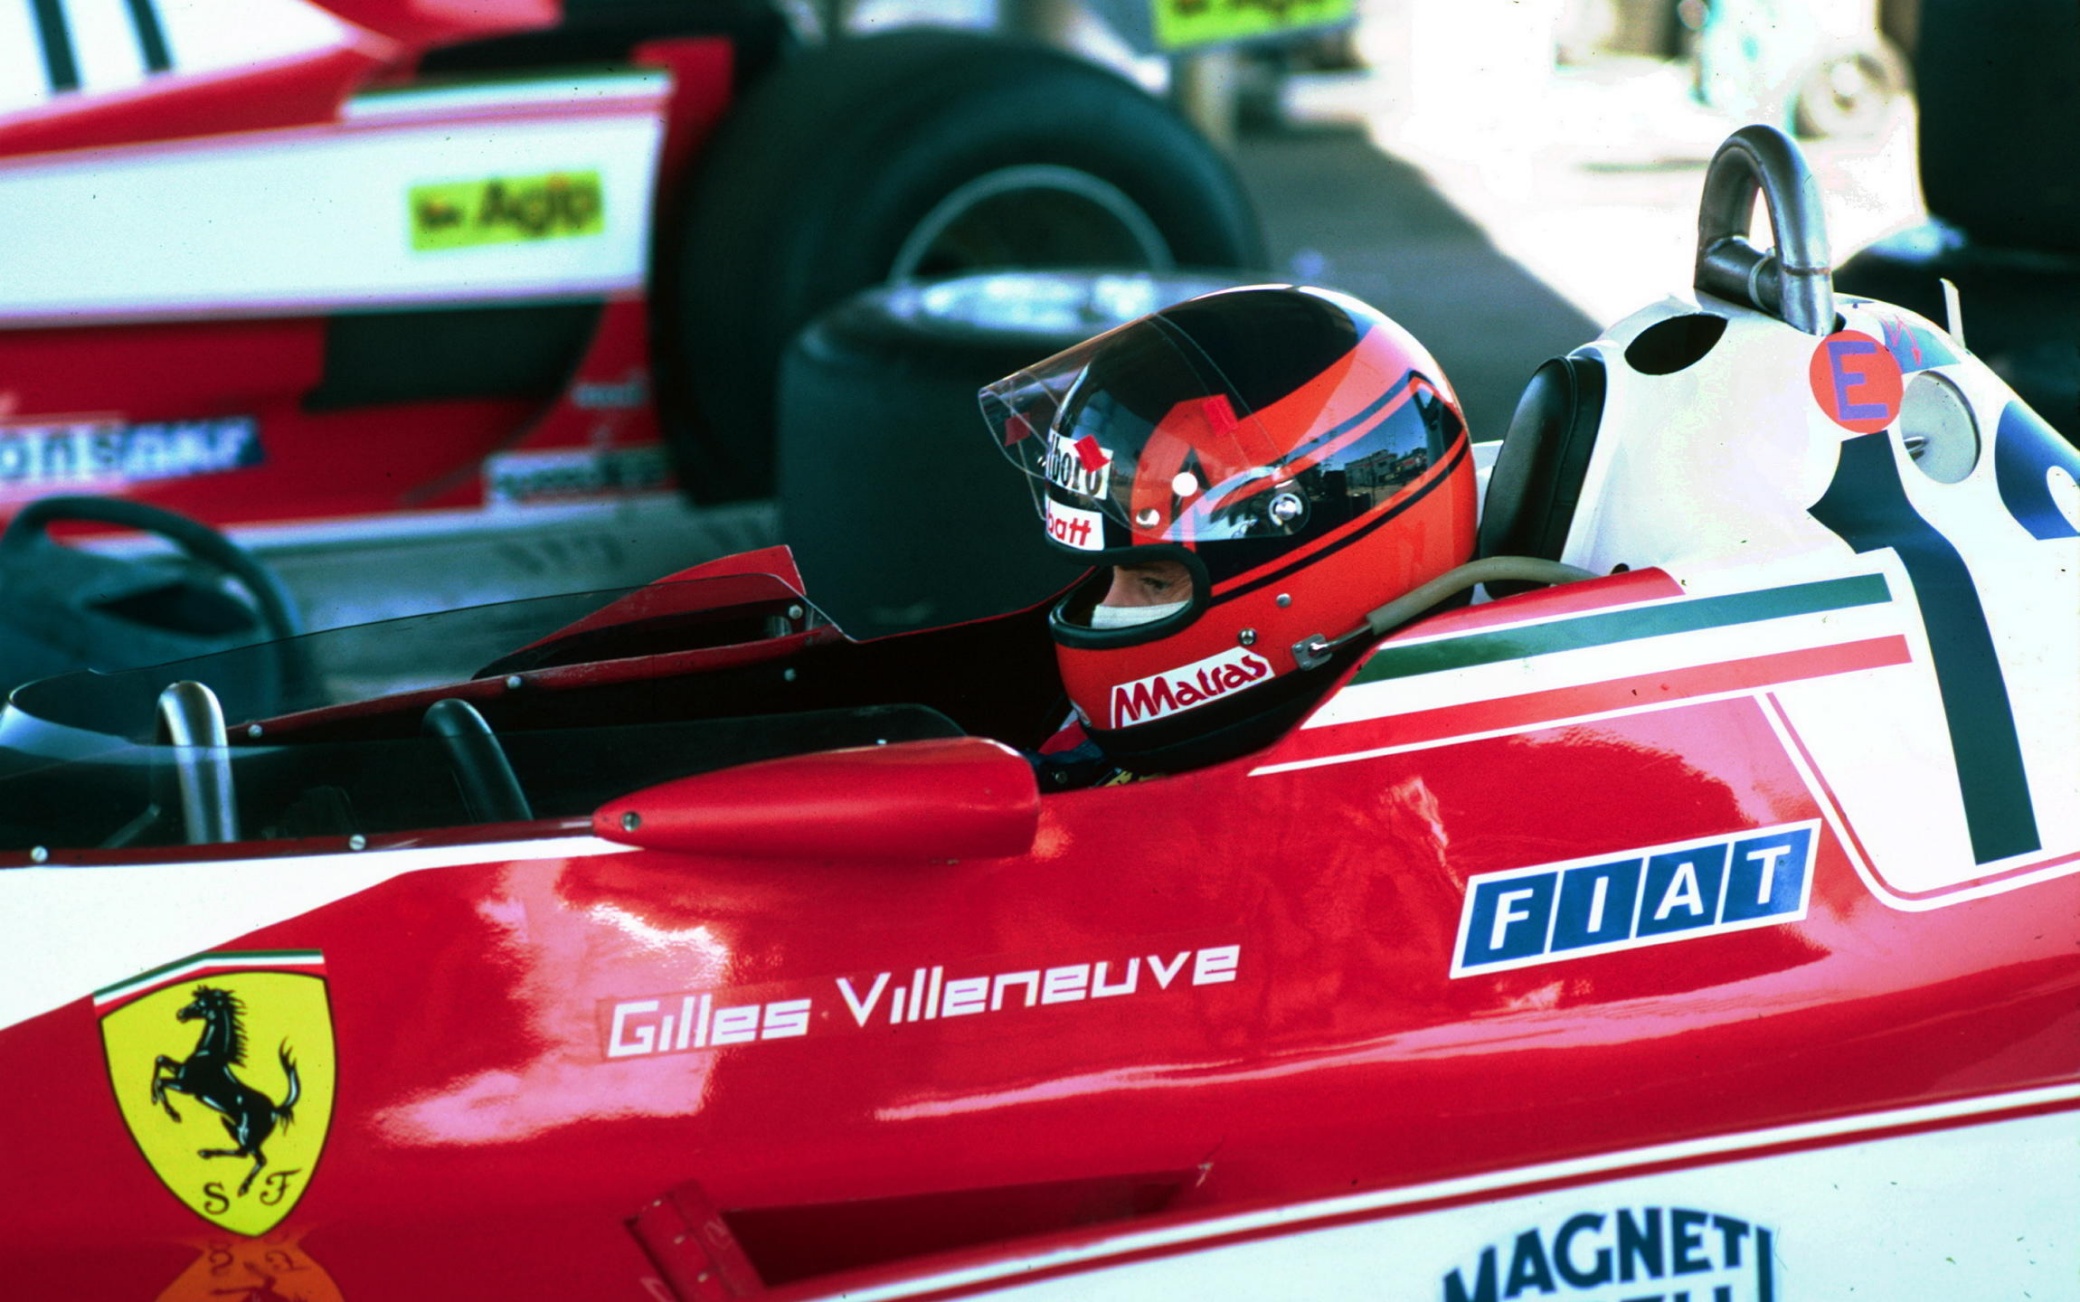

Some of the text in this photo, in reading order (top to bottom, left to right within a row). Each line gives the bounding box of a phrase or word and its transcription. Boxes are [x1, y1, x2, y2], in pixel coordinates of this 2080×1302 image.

[1827, 341, 1890, 421] E
[1115, 655, 1267, 728] Matras
[1490, 845, 1791, 950] FIAT
[608, 945, 1240, 1058] Gilles Villeneuve
[203, 1180, 230, 1215] S
